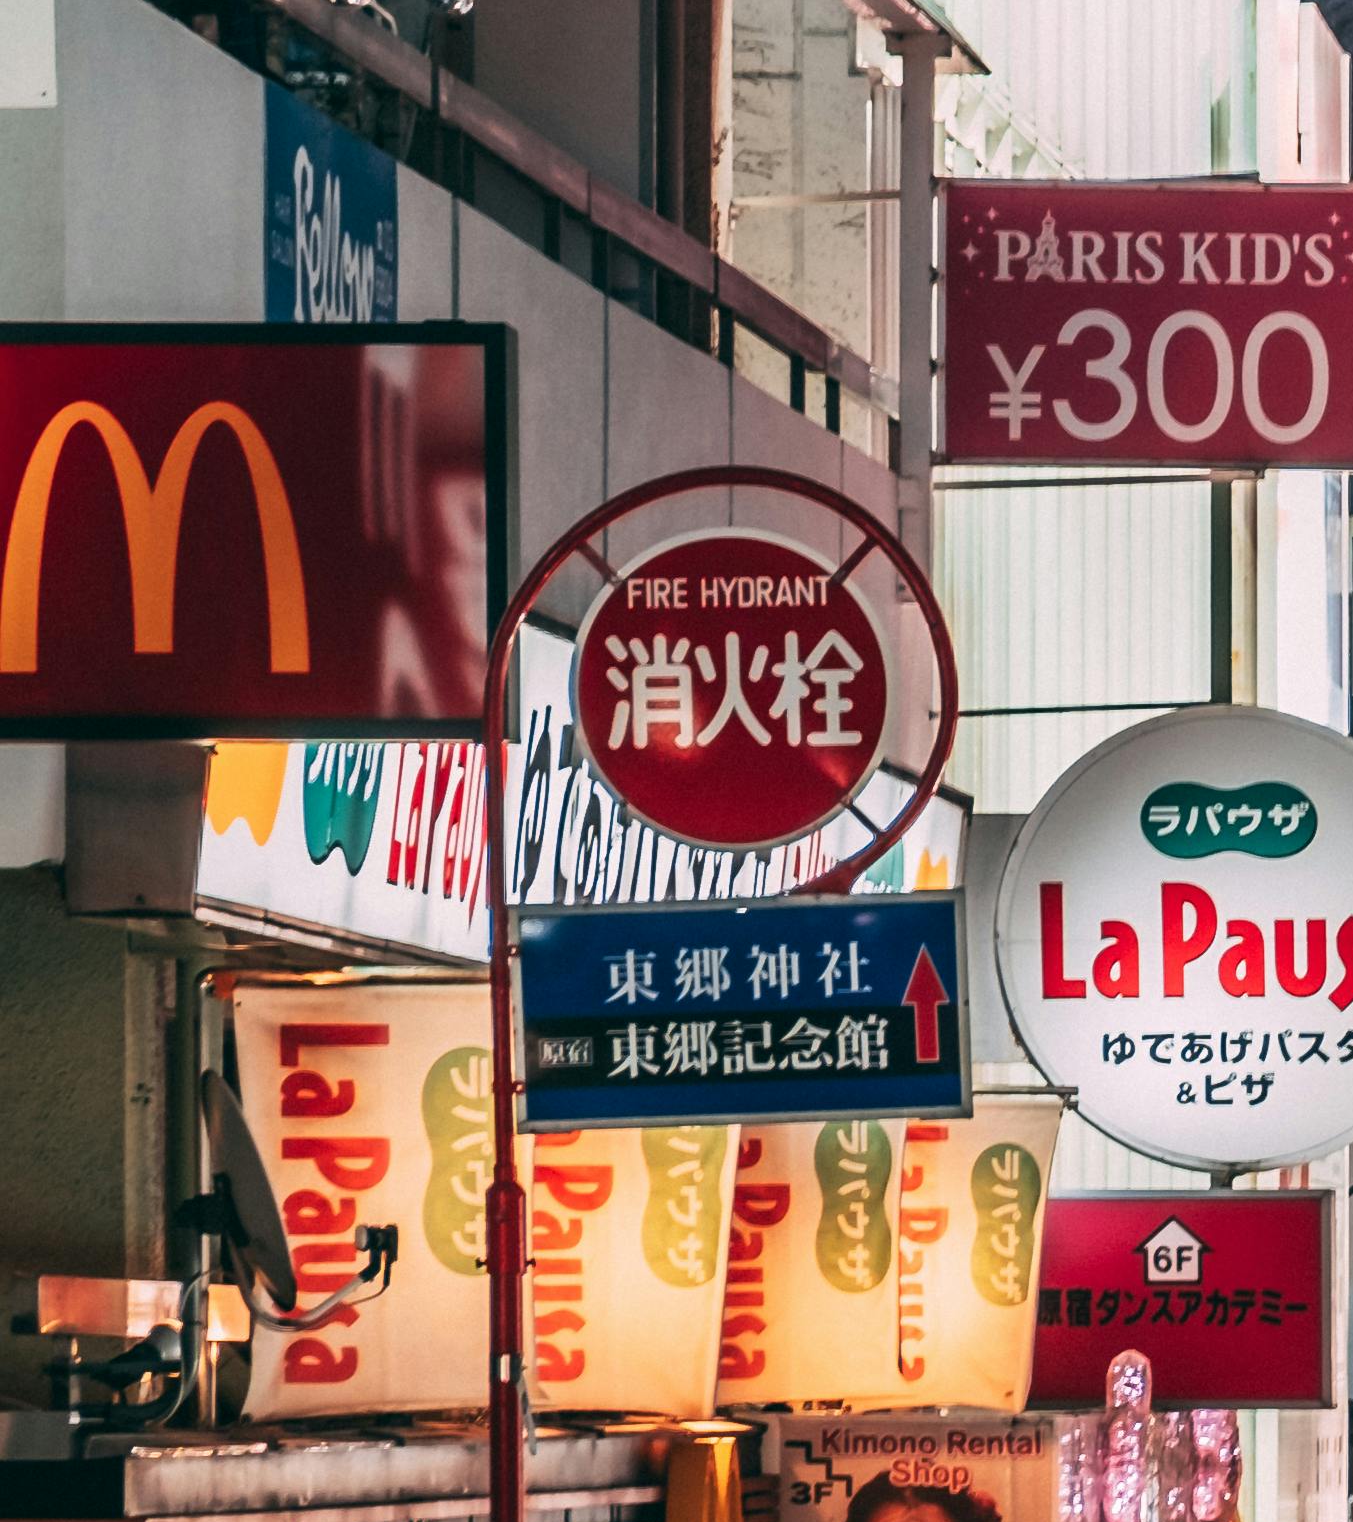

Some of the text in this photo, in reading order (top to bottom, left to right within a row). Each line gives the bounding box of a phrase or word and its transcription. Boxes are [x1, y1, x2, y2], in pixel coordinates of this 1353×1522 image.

[994, 218, 1334, 287] PARIS KID'S
[986, 309, 1330, 443] ¥300
[627, 575, 832, 609] FIRE HYDRANT
[604, 629, 864, 749] 消火栓
[1148, 799, 1309, 837] ラパウザ
[1040, 881, 1139, 1000] La
[606, 941, 872, 1005] 東郷神社
[279, 1023, 391, 1118] La
[607, 1015, 889, 1078] 東郷記念館
[1153, 1246, 1193, 1273] 6F
[1037, 1288, 1308, 1328] 原宿ダンスアカデミー
[821, 1430, 1043, 1456] Kimono Rental
[791, 1481, 833, 1505] 3F
[889, 1459, 971, 1493] Shop
